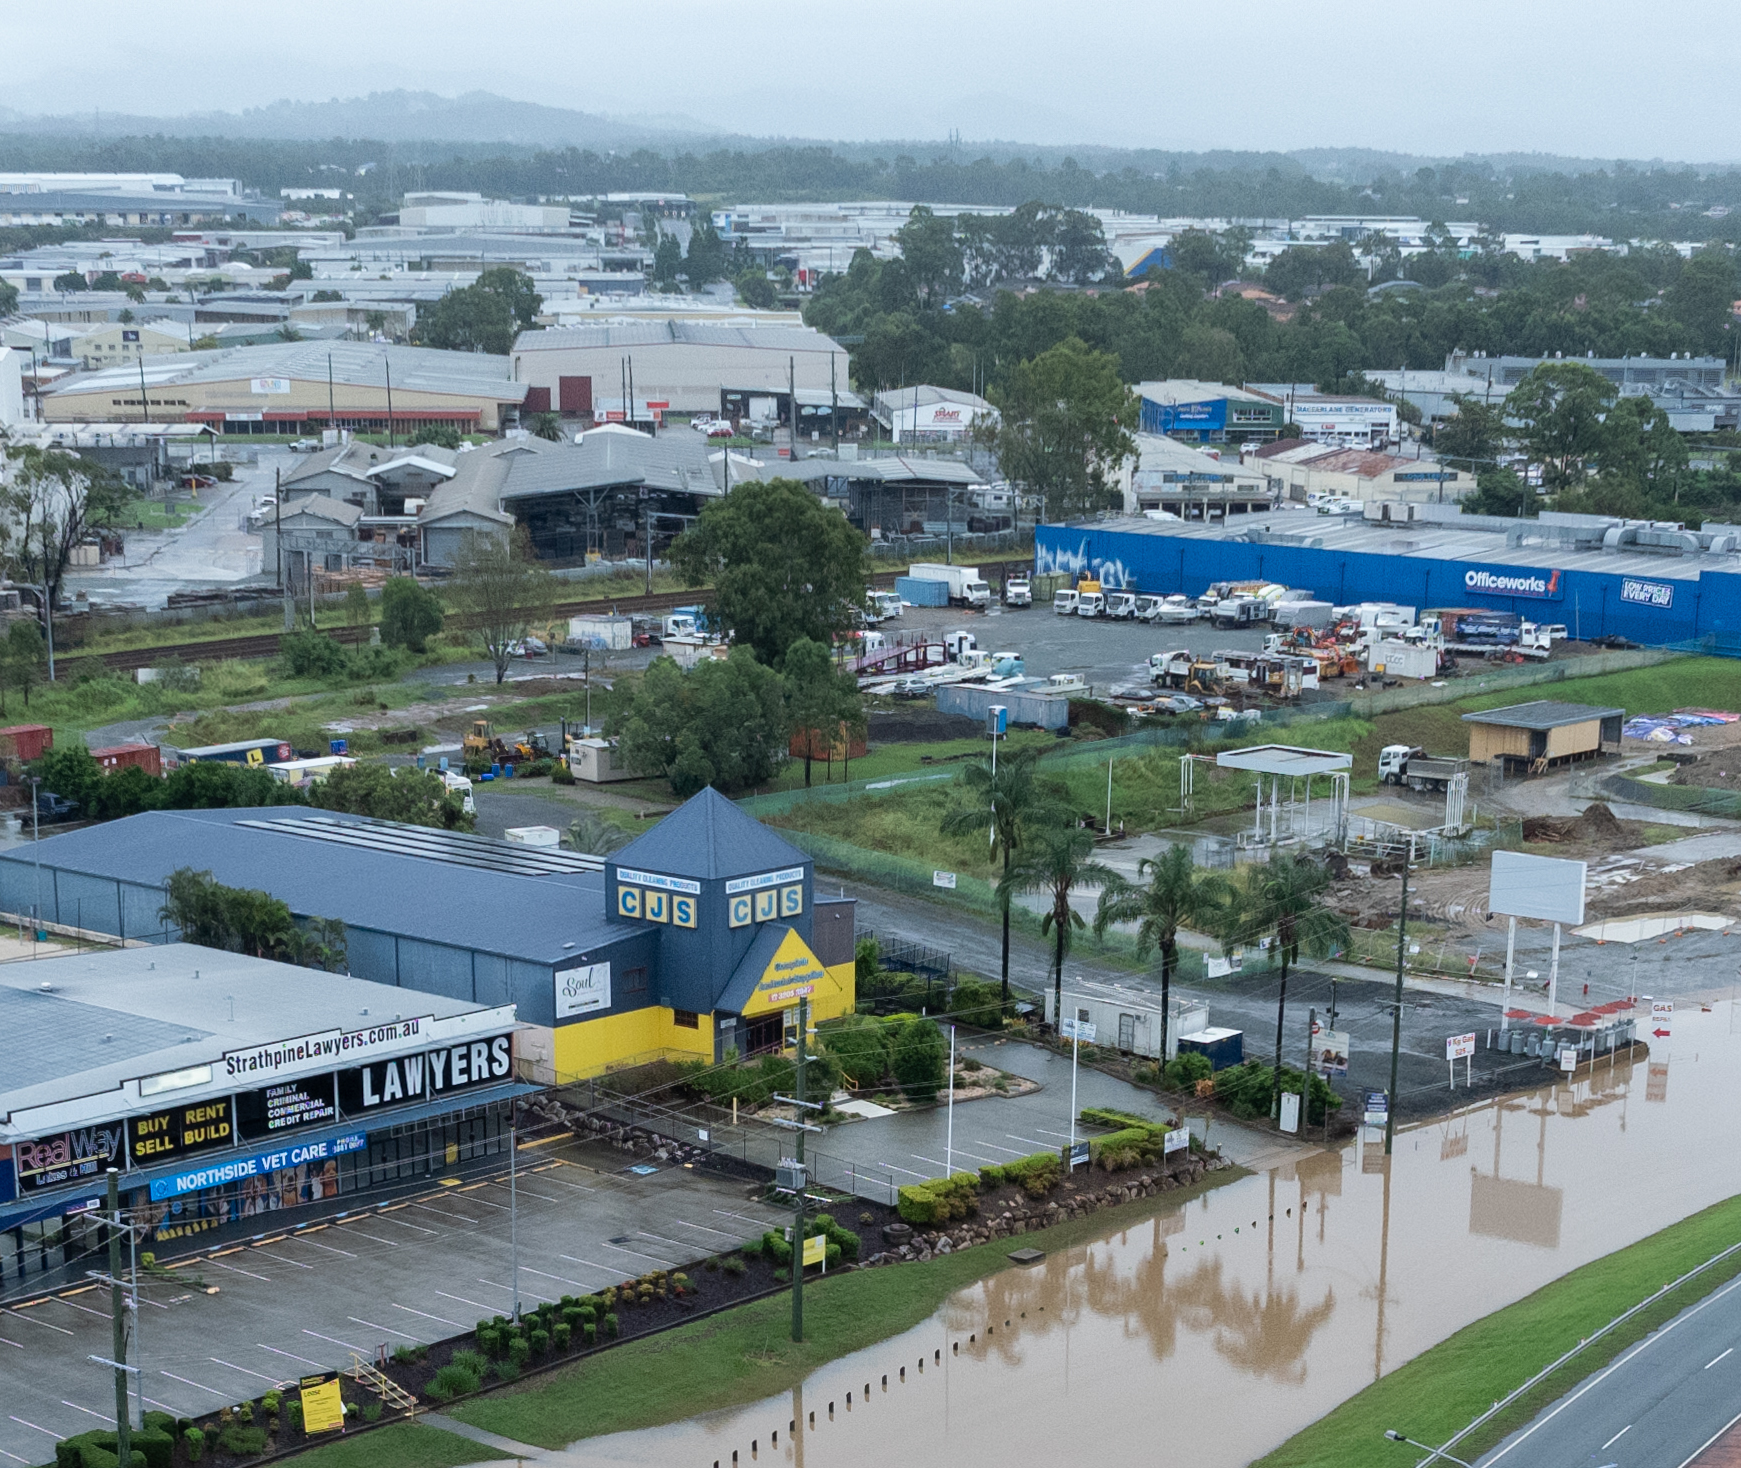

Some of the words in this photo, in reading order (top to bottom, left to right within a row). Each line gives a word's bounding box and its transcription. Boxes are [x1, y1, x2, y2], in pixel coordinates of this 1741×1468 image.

[1465, 571, 1546, 593] Officeworks
[619, 871, 641, 882] QUALITY
[643, 875, 668, 887] CLEANING
[670, 879, 699, 892] PRODUCTS
[728, 881, 749, 892] QUALITY
[751, 876, 774, 889] CLEANING
[775, 871, 802, 885] PRODUCTS
[621, 891, 692, 924] CJS
[733, 888, 800, 924] CJS
[562, 967, 595, 998] Soul
[1653, 1004, 1673, 1013] GAS
[226, 1019, 420, 1075] StrathpineLawyers.com.au
[362, 1036, 510, 1107] LAWYERS
[266, 1083, 298, 1098] FAMILY
[267, 1091, 310, 1108] CRIMINAL
[138, 1116, 170, 1136] BUY
[185, 1103, 227, 1124] RENT
[268, 1098, 325, 1119] COMMERCIAL
[268, 1114, 300, 1130] CREDIT
[303, 1106, 334, 1121] REPAIR
[135, 1137, 174, 1157] SELL
[184, 1122, 231, 1145] BUILD
[176, 1159, 258, 1192] NORTHSIDE
[261, 1151, 288, 1171] VET
[291, 1143, 328, 1164] CARE
